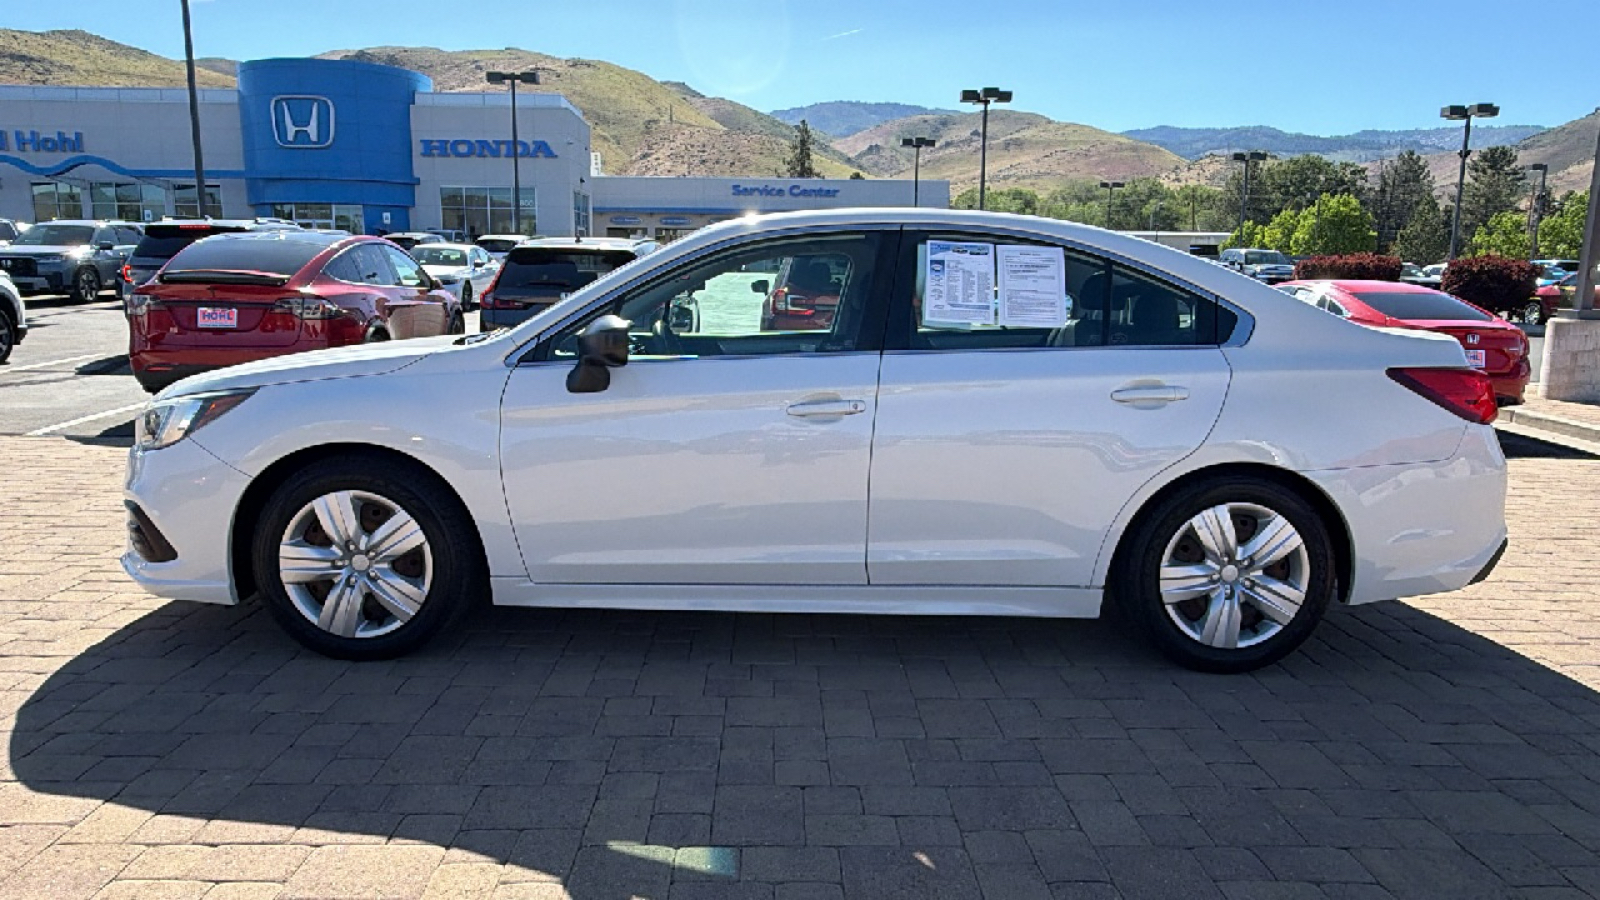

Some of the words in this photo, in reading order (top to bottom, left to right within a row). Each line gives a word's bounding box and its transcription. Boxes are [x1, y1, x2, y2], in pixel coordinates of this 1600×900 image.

[15, 130, 84, 151] Hohl
[420, 140, 558, 158] HONDA
[732, 185, 785, 197] Service
[789, 185, 840, 197] Center
[202, 312, 233, 320] HOHL
